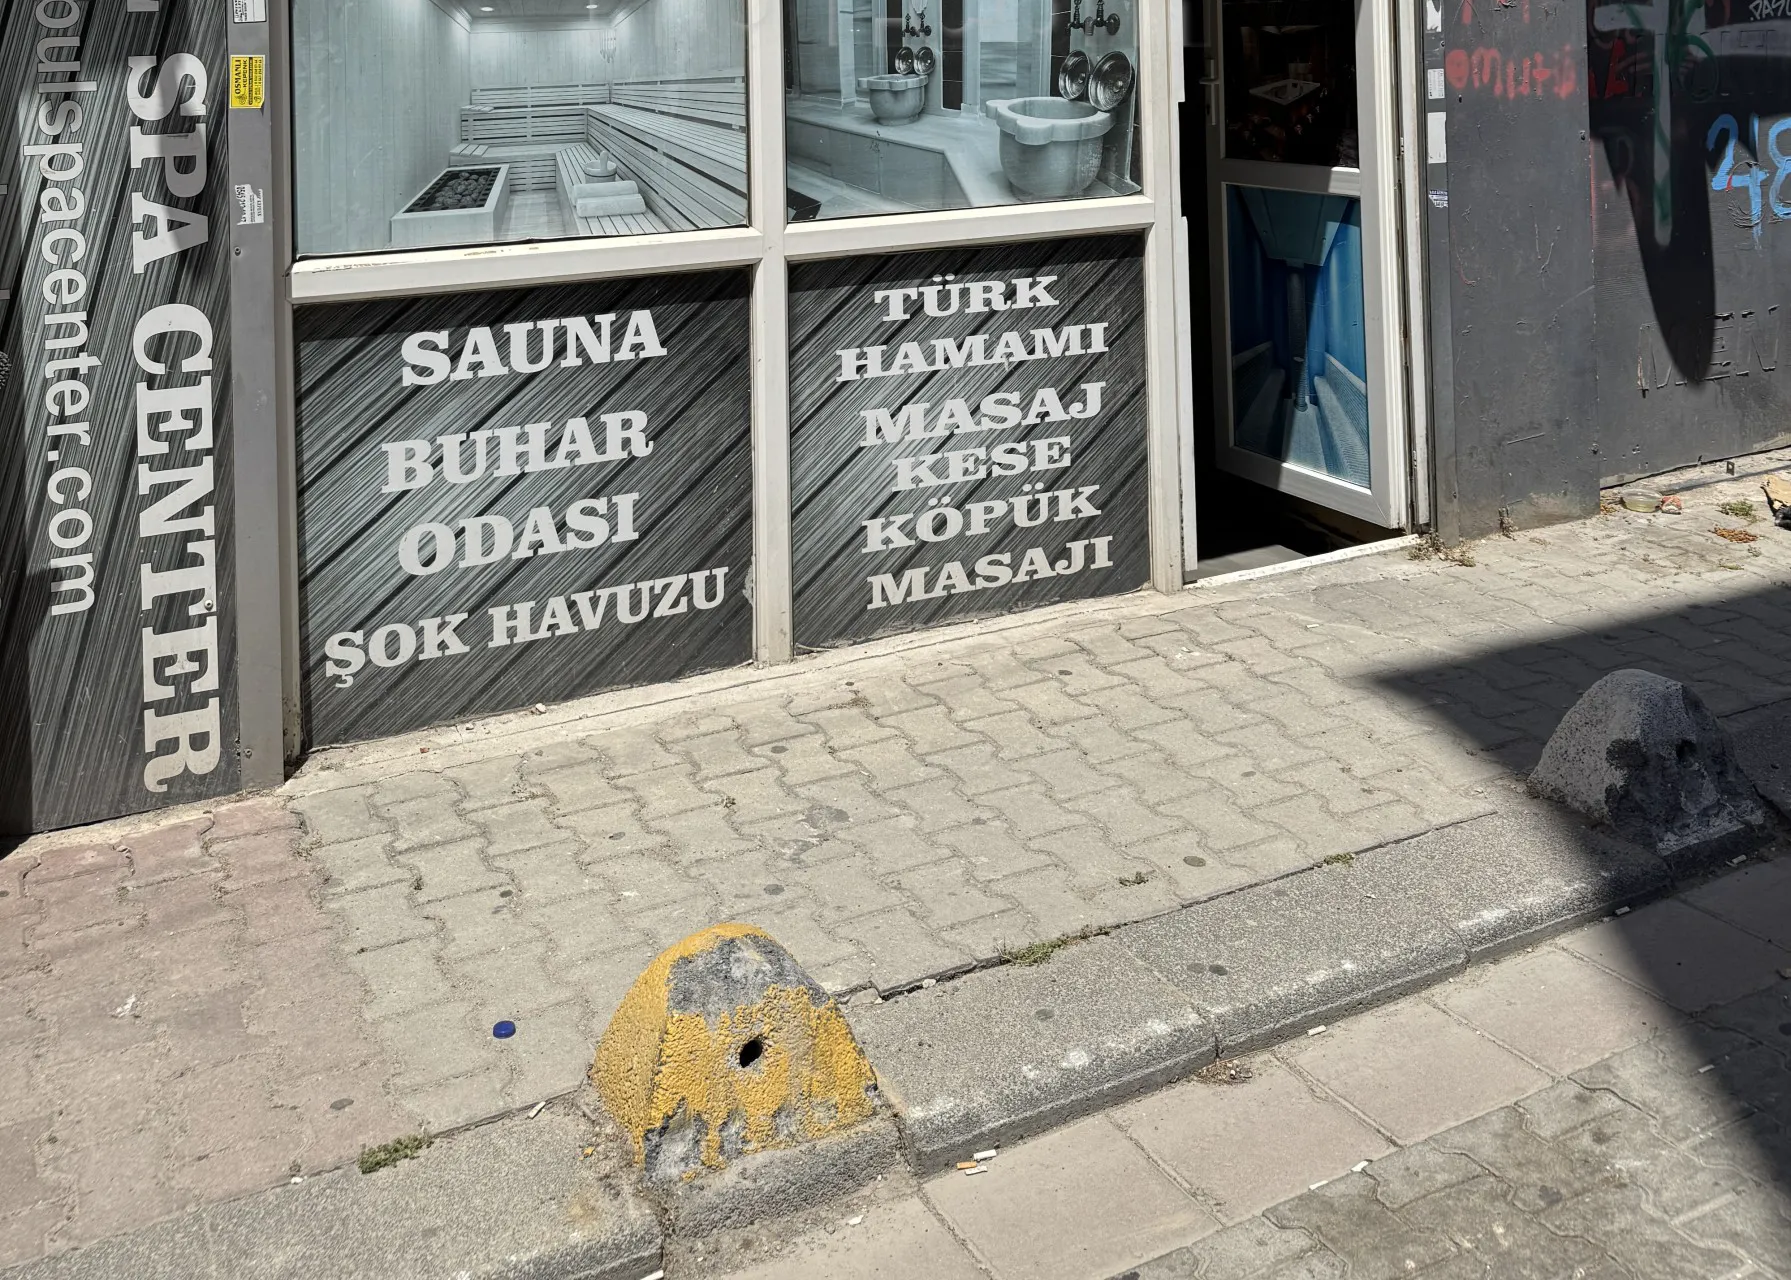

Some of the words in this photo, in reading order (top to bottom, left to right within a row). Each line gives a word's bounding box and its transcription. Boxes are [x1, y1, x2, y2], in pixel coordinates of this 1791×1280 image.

[234, 59, 242, 95] OSMANLI
[127, 52, 210, 274] SPA
[874, 273, 1060, 322] TÜRK
[401, 309, 667, 387] SAUNA
[835, 322, 1109, 382] HAMAMI
[381, 409, 654, 494] BUHAR
[860, 381, 1106, 447] MASAJ
[891, 435, 1071, 492] KESE
[132, 303, 222, 794] CENTER
[398, 492, 640, 576] ODASI
[861, 481, 1102, 553] KÖPÜK
[866, 535, 1114, 610] MASAJI
[324, 612, 470, 688] ŞOK
[487, 566, 729, 649] HAVUZU
